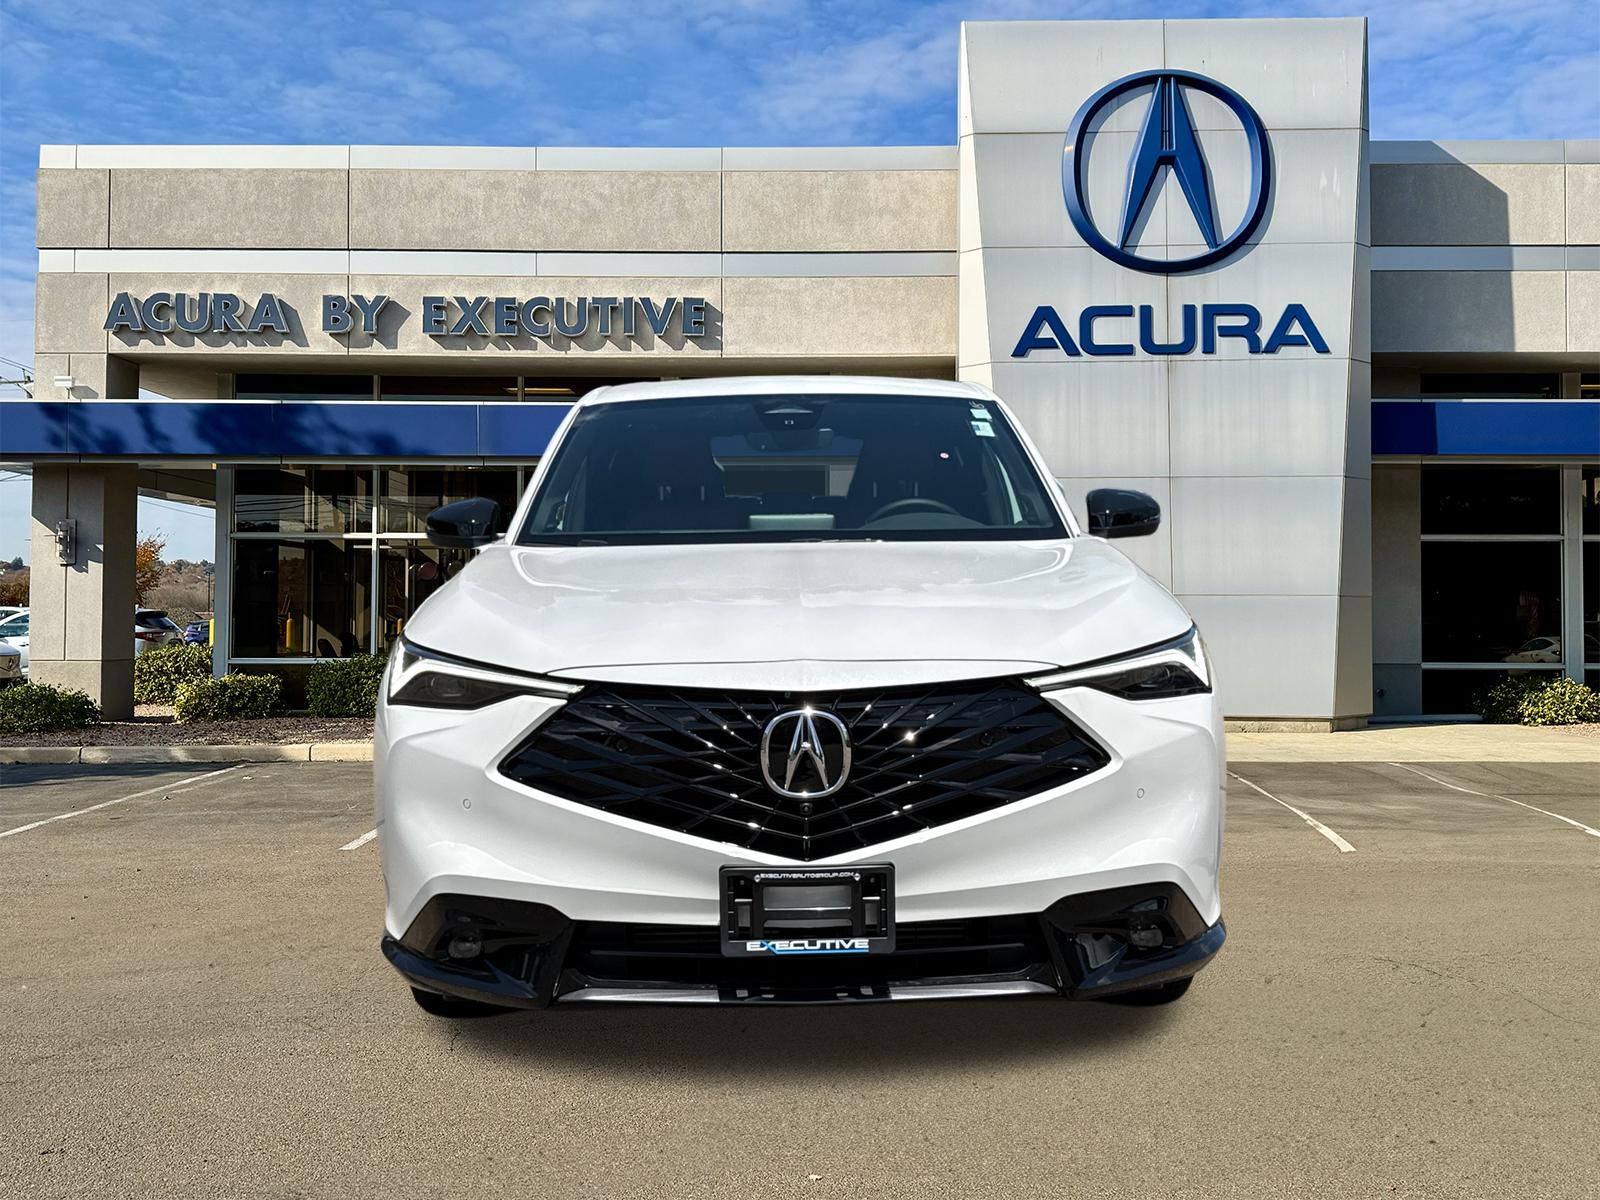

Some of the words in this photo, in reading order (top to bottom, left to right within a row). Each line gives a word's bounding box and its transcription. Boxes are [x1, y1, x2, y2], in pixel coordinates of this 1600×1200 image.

[104, 292, 290, 334] ACURA
[322, 295, 392, 335] BY
[422, 296, 708, 338] EXECUTIVE
[1011, 303, 1332, 357] ACURA
[760, 872, 854, 880] EXECUTIVEAUTOGROUP.COM
[746, 938, 870, 953] EXECUTIVE
